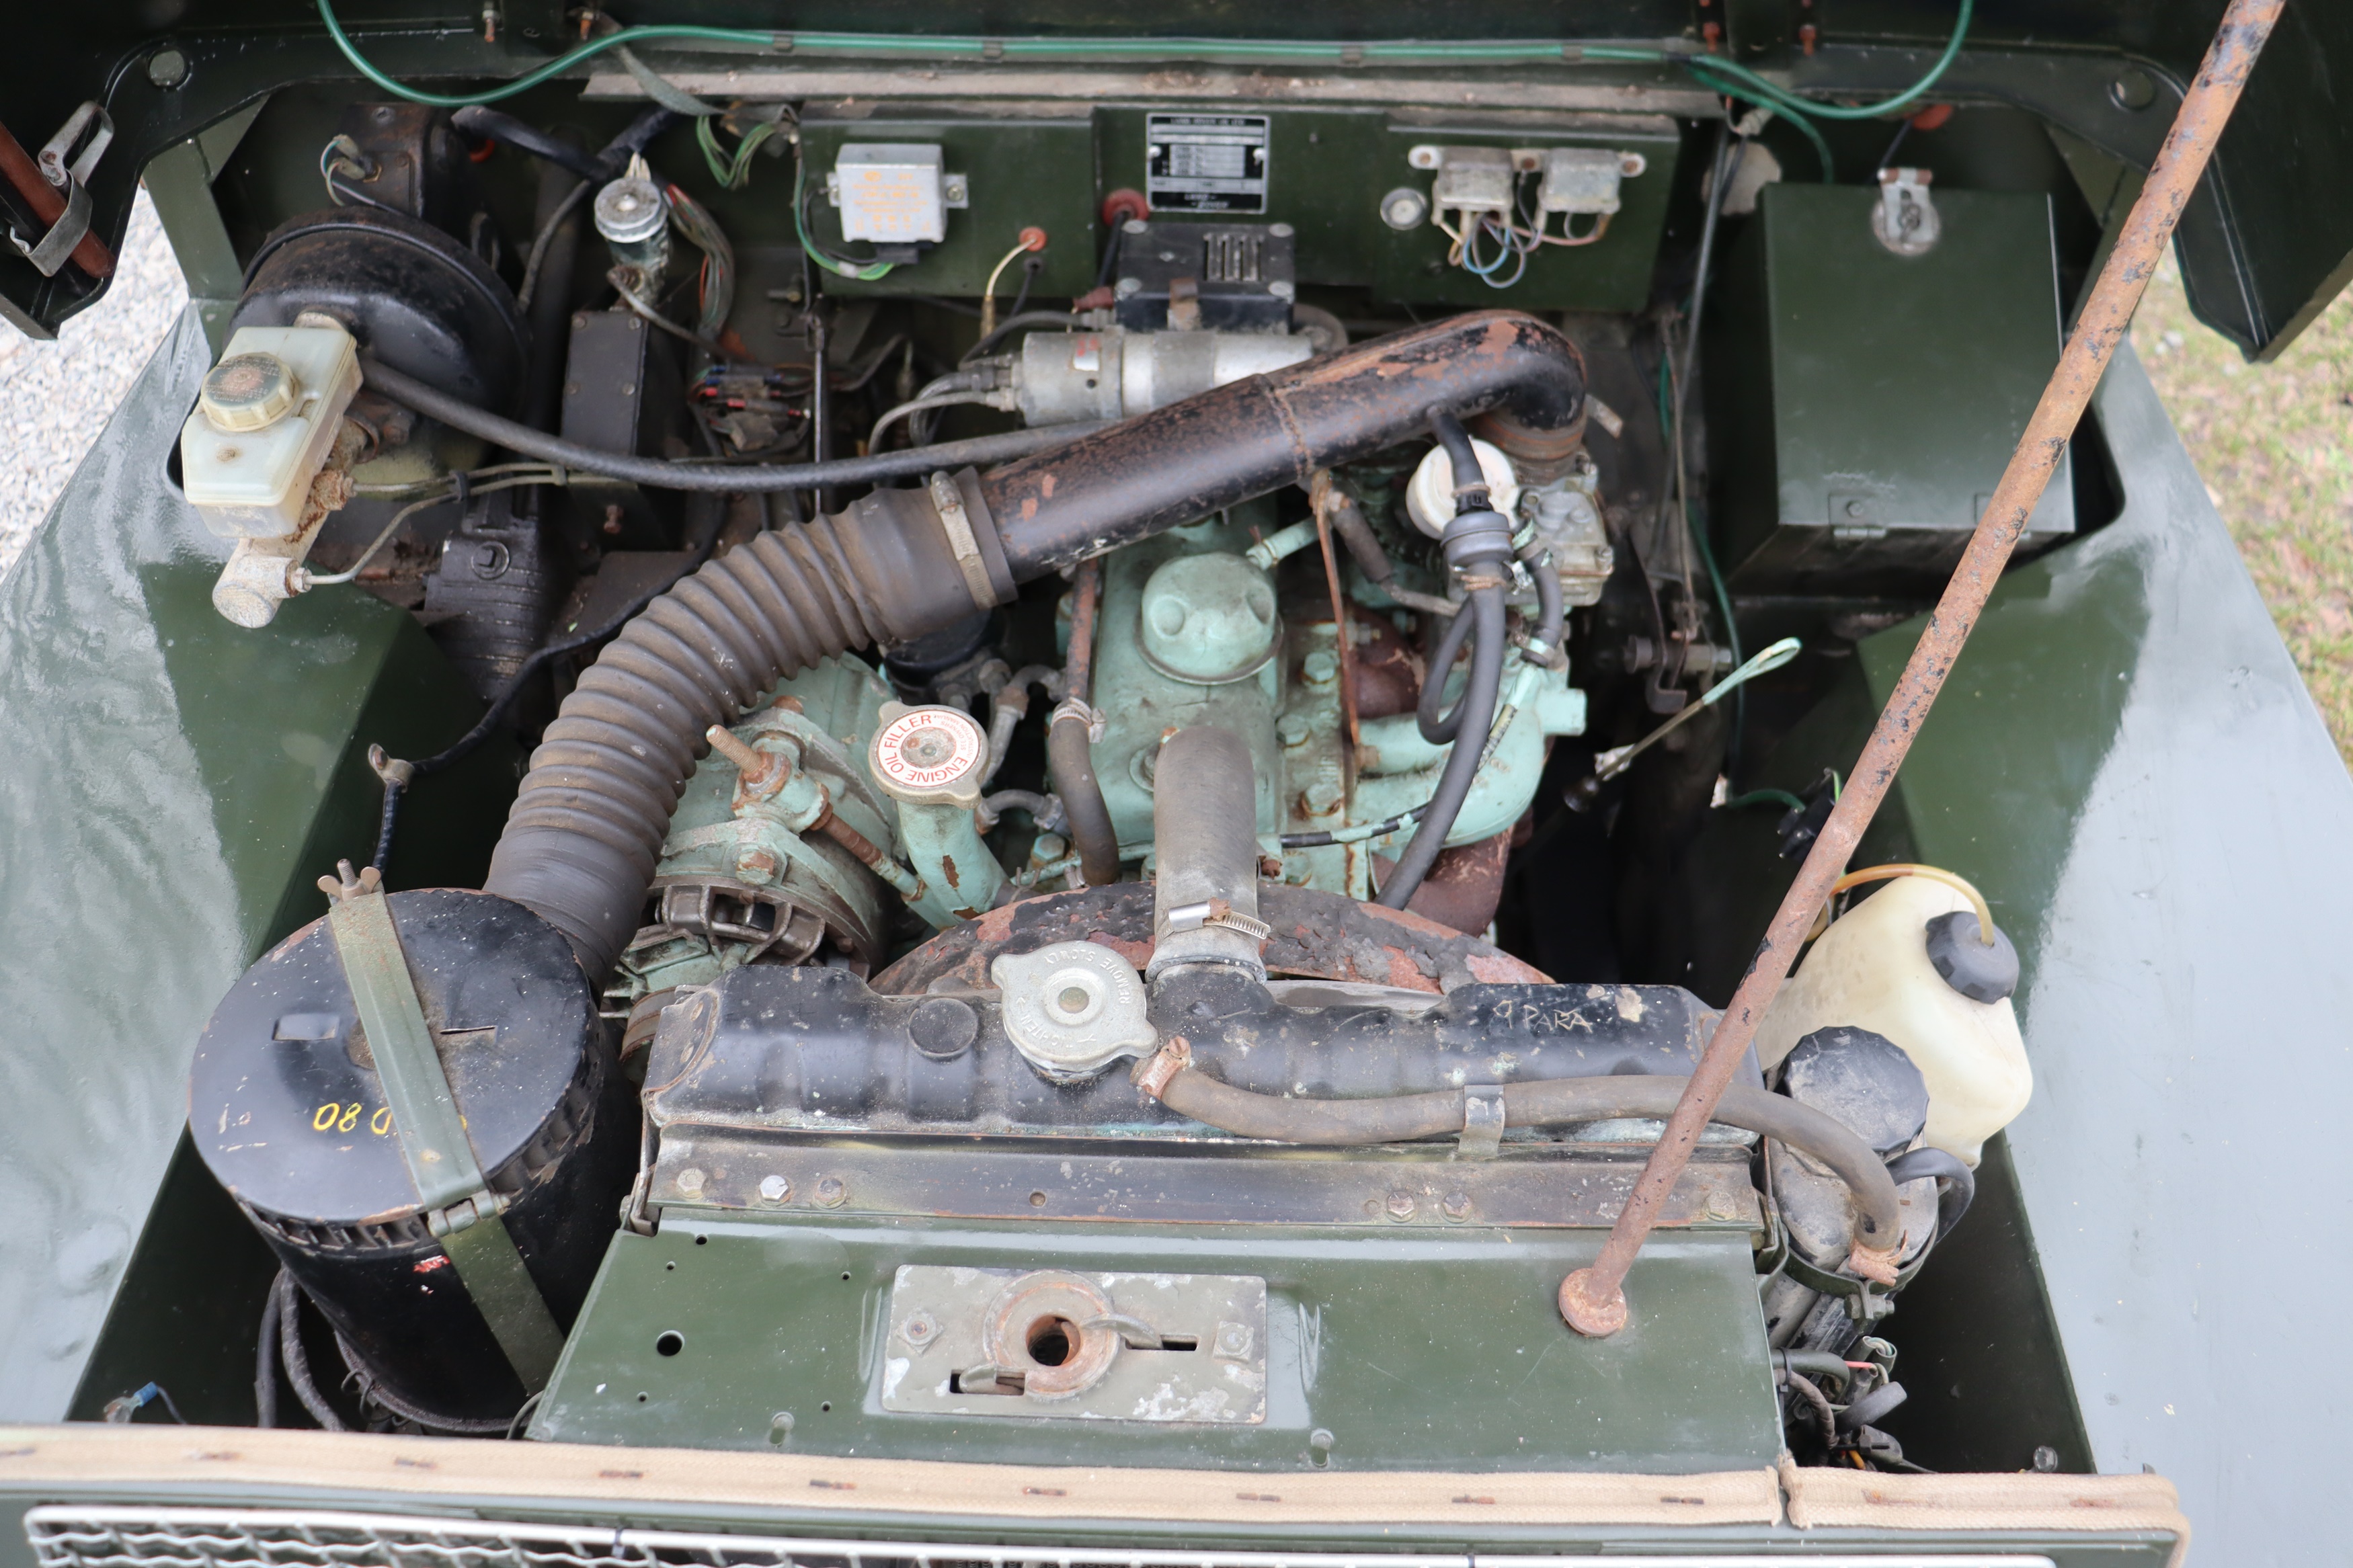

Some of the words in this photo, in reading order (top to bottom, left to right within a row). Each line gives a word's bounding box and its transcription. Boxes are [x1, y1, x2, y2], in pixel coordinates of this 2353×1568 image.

[884, 714, 932, 748] FILLER
[885, 752, 904, 773] OIL
[906, 757, 968, 782] ENGINE
[1044, 948, 1096, 964] SLOWLY
[1100, 957, 1131, 1004] REMOVE
[1021, 1015, 1074, 1048] TGHTEN
[1522, 1003, 1593, 1034] PARA
